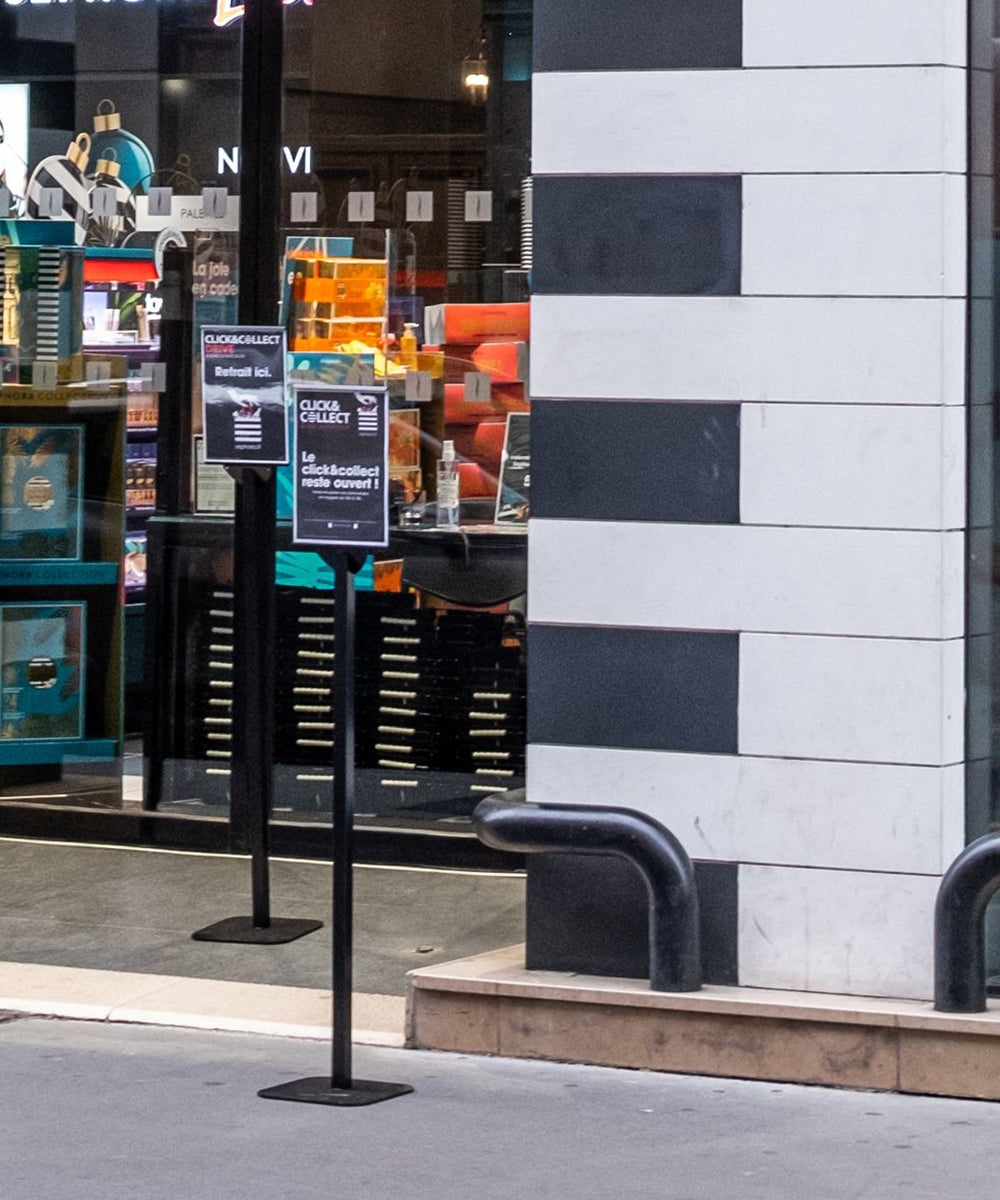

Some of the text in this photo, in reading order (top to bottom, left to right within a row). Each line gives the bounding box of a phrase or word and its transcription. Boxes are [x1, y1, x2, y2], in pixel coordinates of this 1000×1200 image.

[192, 260, 230, 280] La joie
[214, 366, 272, 378] Retrait ici.
[299, 399, 341, 412] CLICK&
[299, 412, 351, 424] COLLECT
[301, 451, 316, 463] Le
[301, 464, 380, 478] click&collect
[301, 477, 331, 488] reste
[333, 477, 372, 490] ouvert
